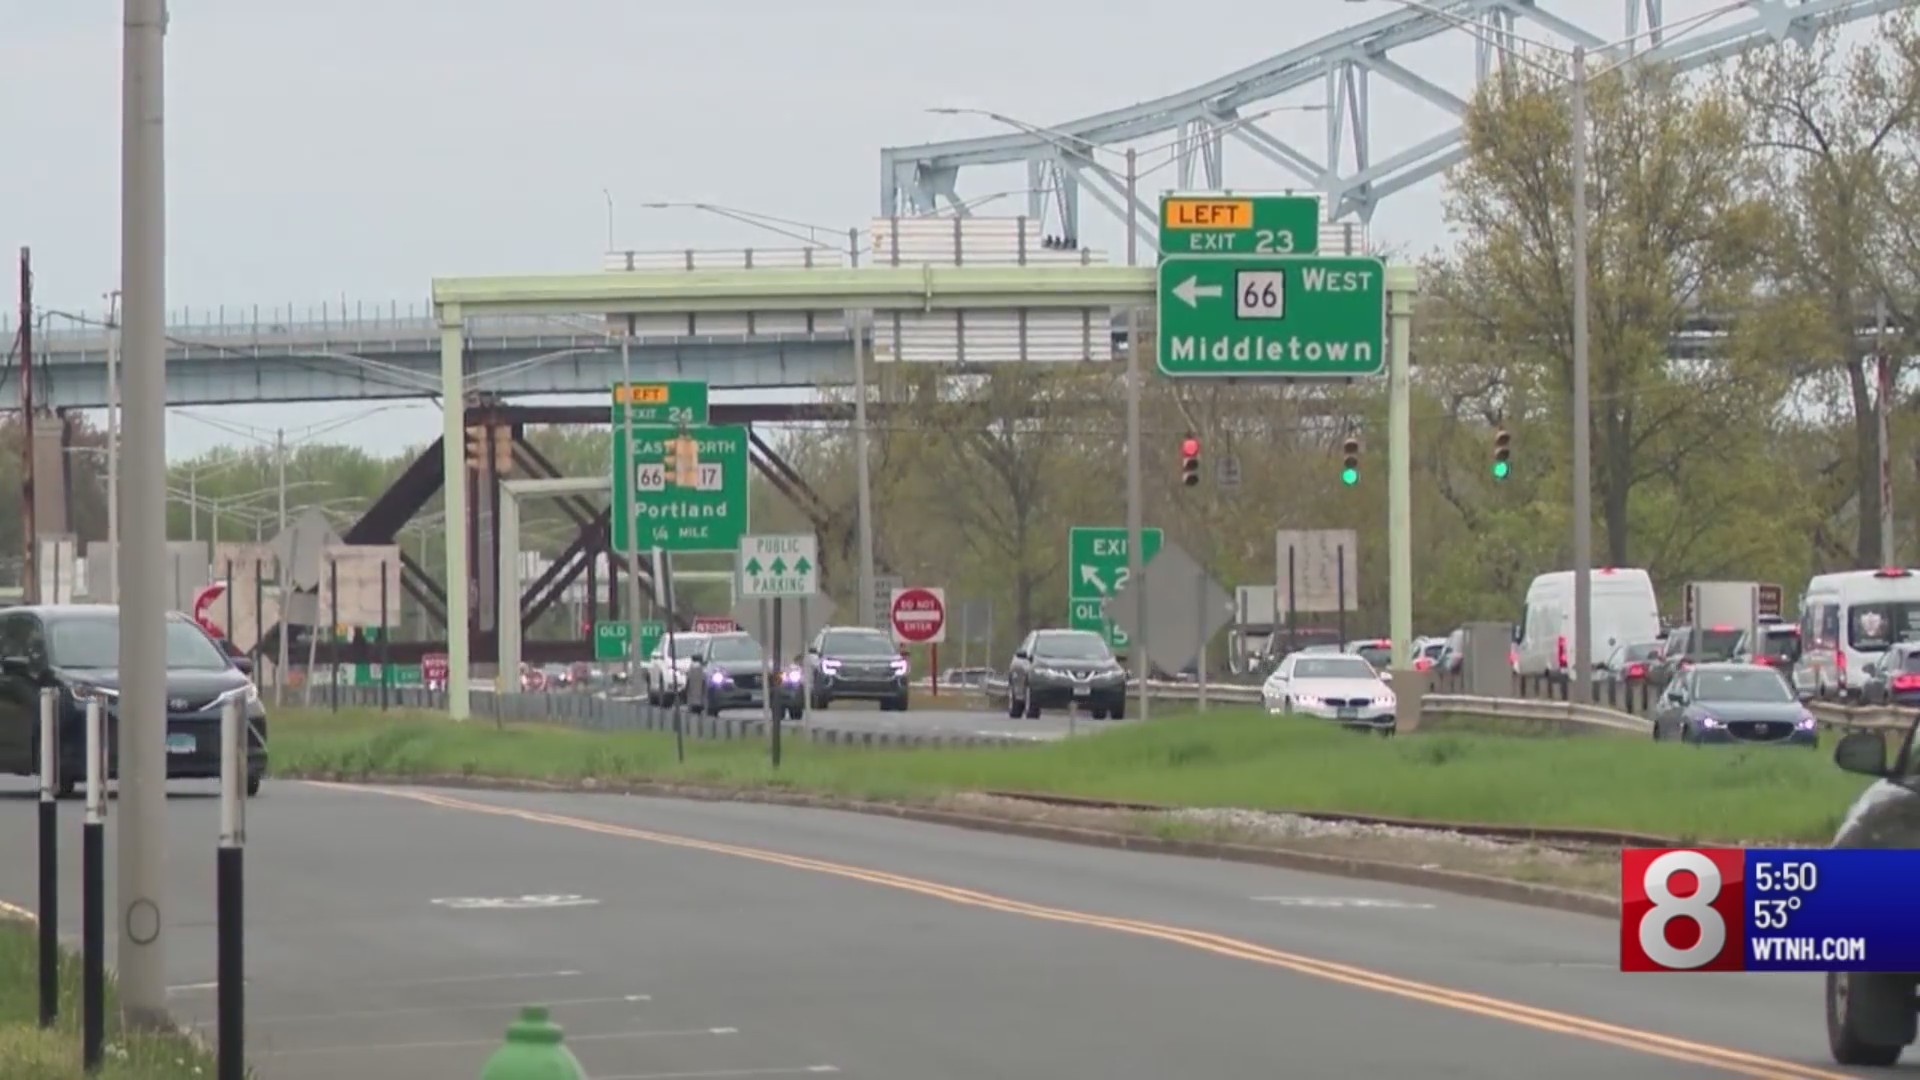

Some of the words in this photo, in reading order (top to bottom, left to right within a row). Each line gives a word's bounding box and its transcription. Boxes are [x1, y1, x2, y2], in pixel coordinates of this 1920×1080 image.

[1179, 205, 1239, 224] LEFT
[1190, 233, 1236, 250] EXIT
[1256, 230, 1294, 253] 23
[1244, 281, 1277, 308] 66
[1302, 267, 1372, 291] WEST
[1171, 335, 1371, 361] Middletown
[631, 388, 660, 401] EFT
[668, 406, 694, 422] 24
[697, 441, 736, 454] ORTH
[641, 468, 662, 486] 66
[702, 468, 717, 486] 17
[635, 502, 727, 518] Portland
[679, 526, 709, 538] MILE
[756, 538, 800, 554] PUBLIC
[1093, 539, 1128, 556] EXI
[752, 577, 805, 592] PARKING
[1114, 566, 1131, 590] 2
[900, 599, 914, 609] DO
[917, 599, 935, 609] NOT
[600, 625, 627, 637] OLD
[641, 625, 661, 637] XIT
[904, 622, 933, 633] ENTER
